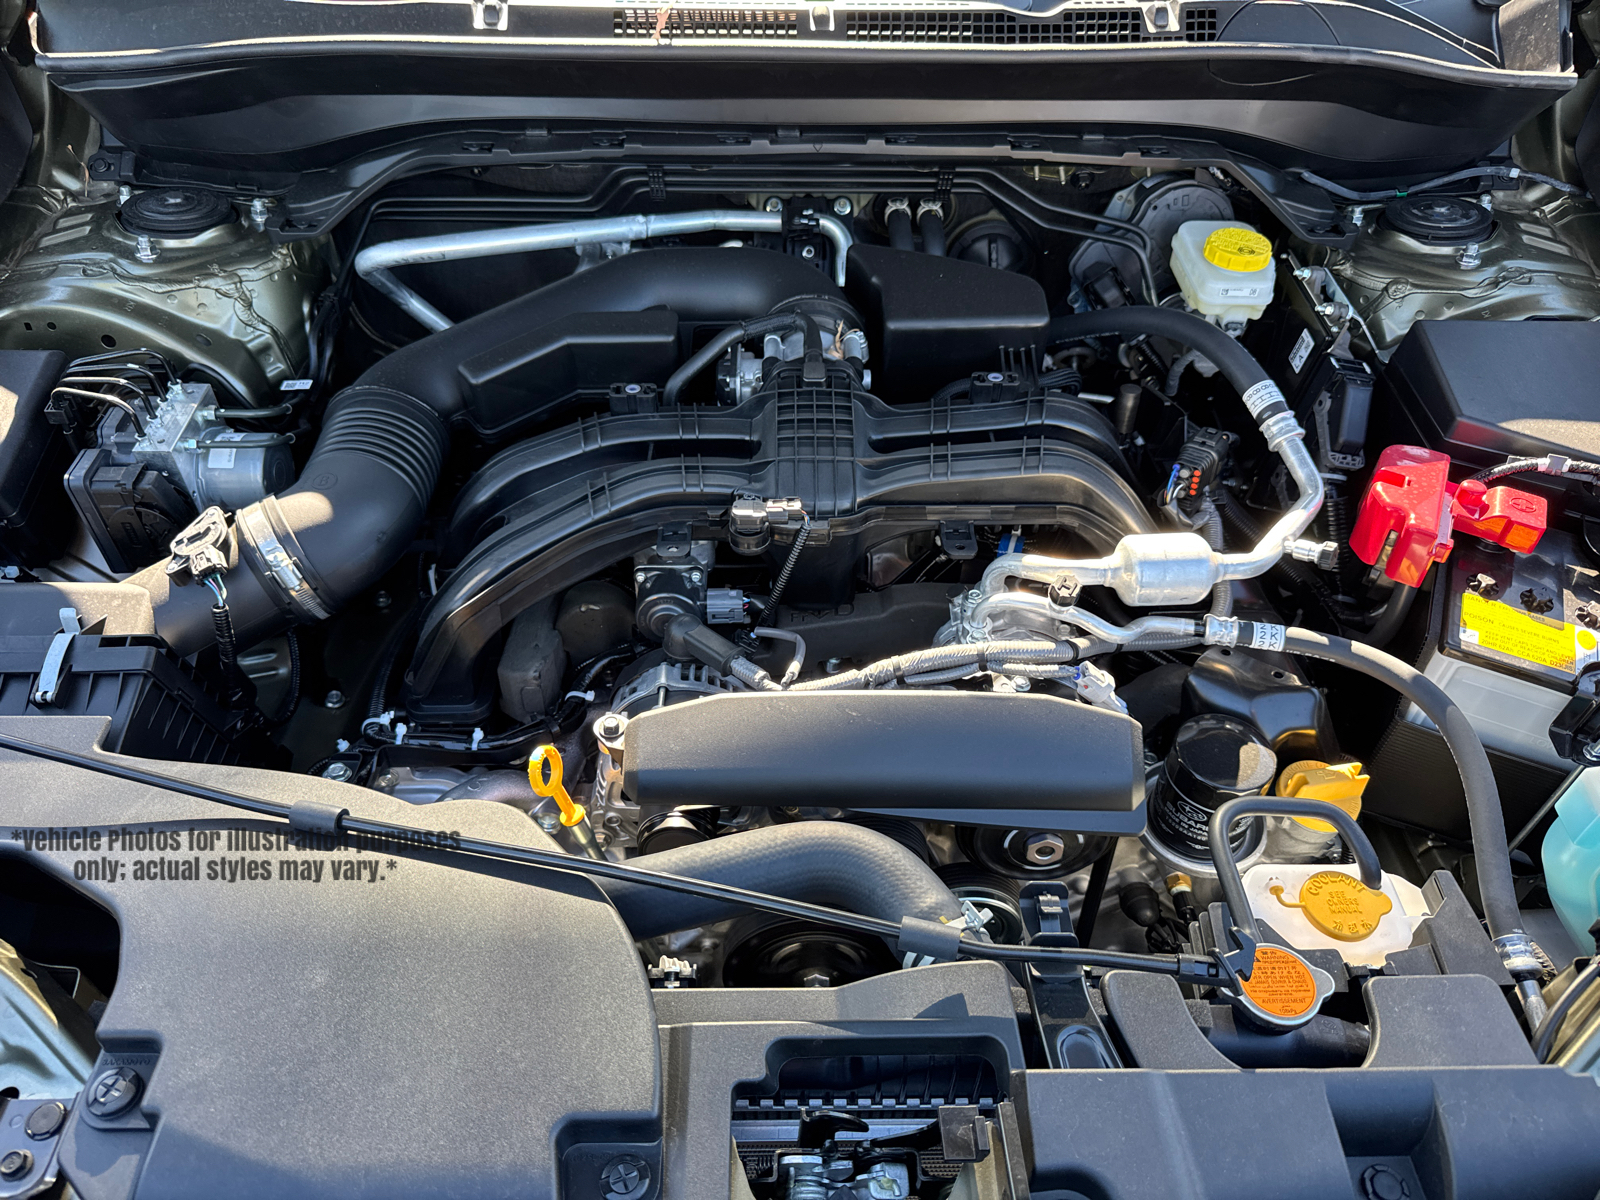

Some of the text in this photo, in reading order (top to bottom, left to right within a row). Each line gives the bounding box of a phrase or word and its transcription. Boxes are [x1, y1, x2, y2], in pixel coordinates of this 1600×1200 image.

[1465, 595, 1497, 607] DANGR
[1464, 612, 1494, 624] POISON
[1499, 621, 1519, 632] CAUSES
[1520, 629, 1540, 639] SEVERE
[1542, 635, 1559, 644] BURNS
[1482, 639, 1498, 647] 20HR
[1516, 649, 1531, 658] CCA
[1532, 654, 1548, 664] 620A
[1514, 639, 1528, 647] CAPS
[1520, 645, 1538, 653] REACH
[1547, 654, 1574, 665] CHILDREN
[1164, 806, 1208, 836] MADE IN JAPA
[1307, 873, 1366, 897] COOLANT
[1328, 891, 1346, 899] SEE
[1329, 906, 1363, 915] MANUAL
